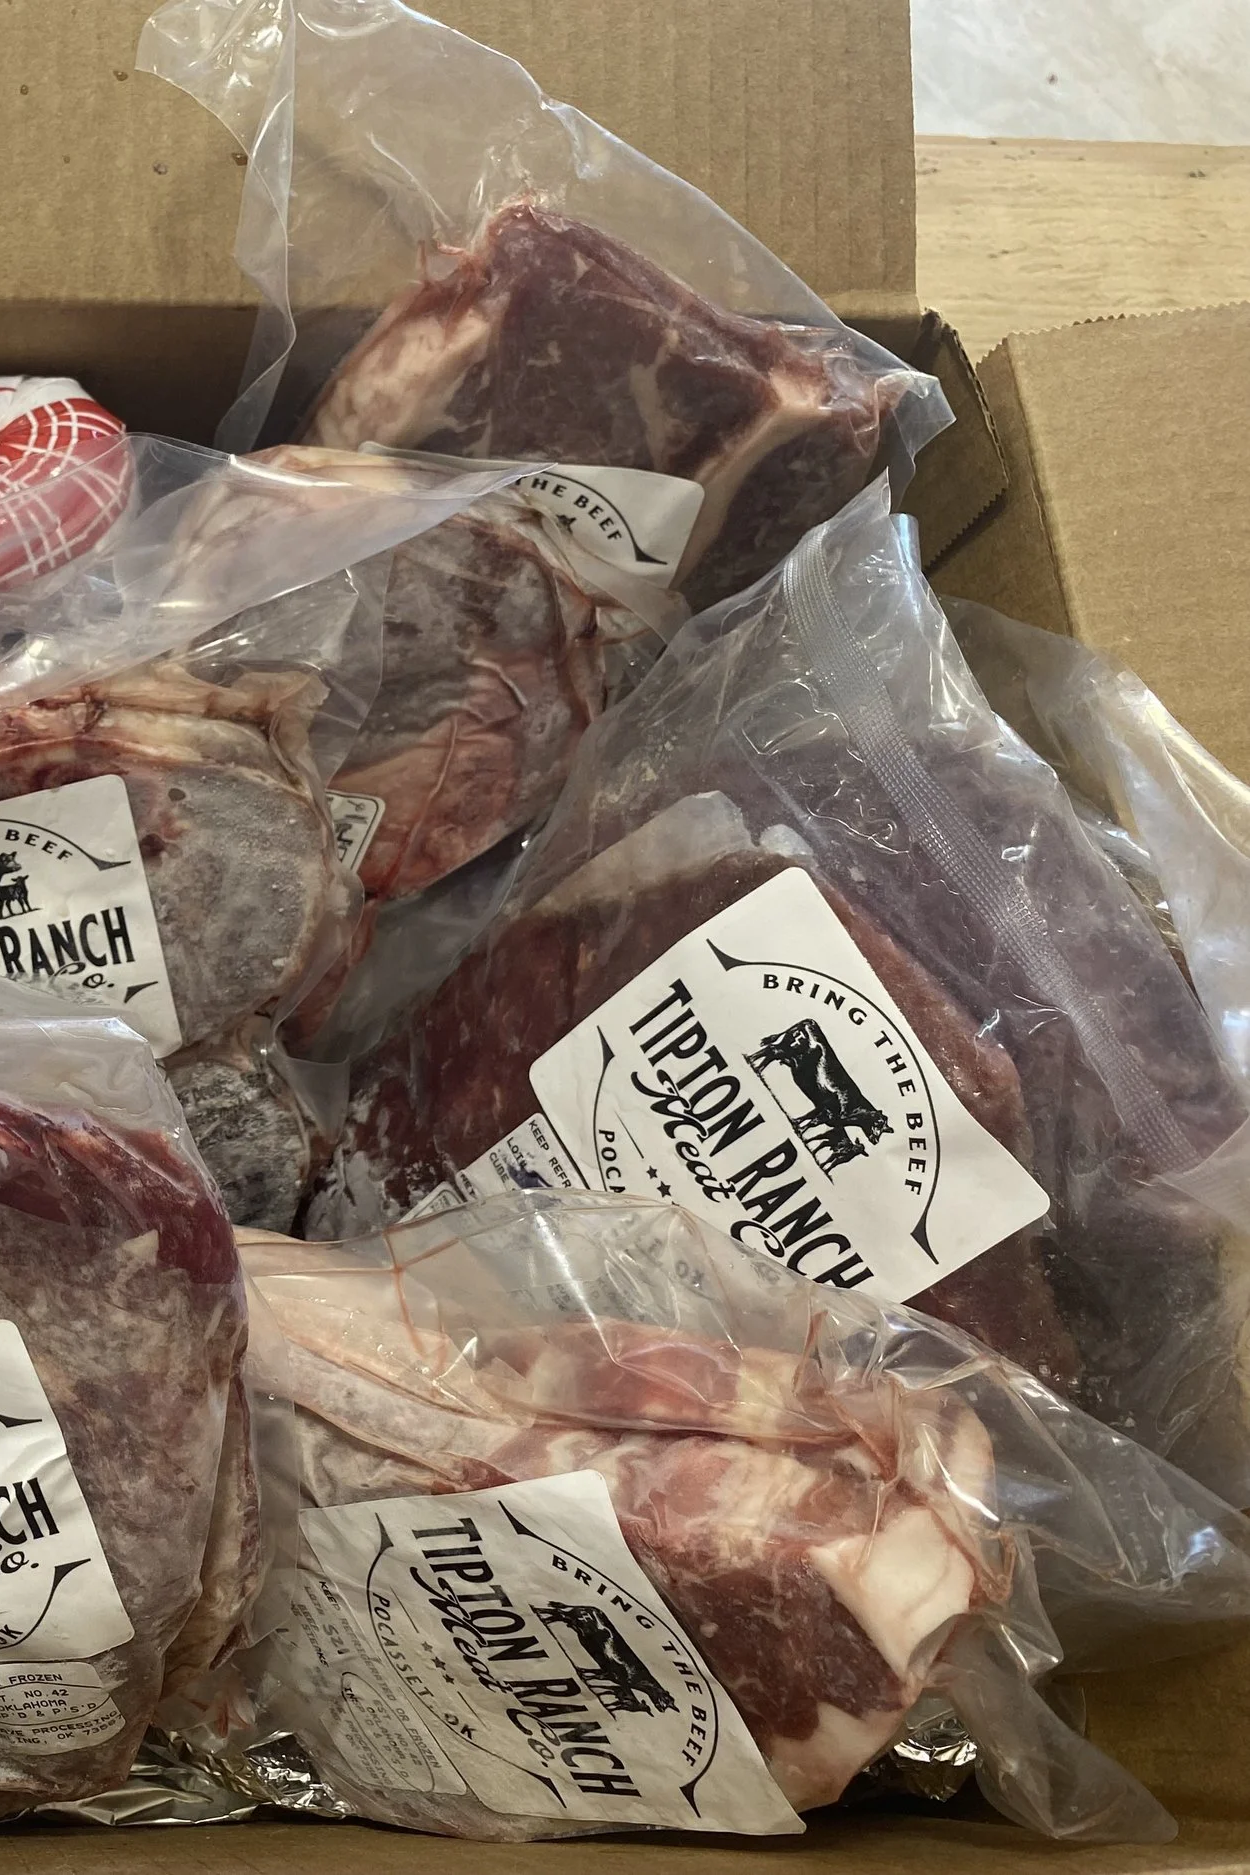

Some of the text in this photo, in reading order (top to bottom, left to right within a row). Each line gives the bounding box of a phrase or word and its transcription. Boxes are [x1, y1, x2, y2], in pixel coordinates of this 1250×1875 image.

[573, 494, 623, 542] BEEF
[4, 830, 74, 861] BEEF
[762, 973, 927, 1196] BRING THE BEEF
[528, 1119, 550, 1151] KEEP
[629, 978, 765, 1158] TIPTON
[733, 1138, 875, 1290] RANCH
[630, 1070, 737, 1203] Meat
[489, 1152, 510, 1184] CUBE
[319, 1581, 341, 1611] KEEP
[396, 1708, 410, 1722] OR
[411, 1566, 555, 1768] Meat Co.
[412, 1517, 642, 1798] TIPTON RANCH
[551, 1554, 708, 1768] BRING THE BEEF
[8, 1674, 63, 1685] FROZEN
[31, 1710, 118, 1736] PROCESSING
[36, 1710, 45, 1718] &
[52, 1702, 97, 1715] P'S'D
[57, 1732, 75, 1740] OK
